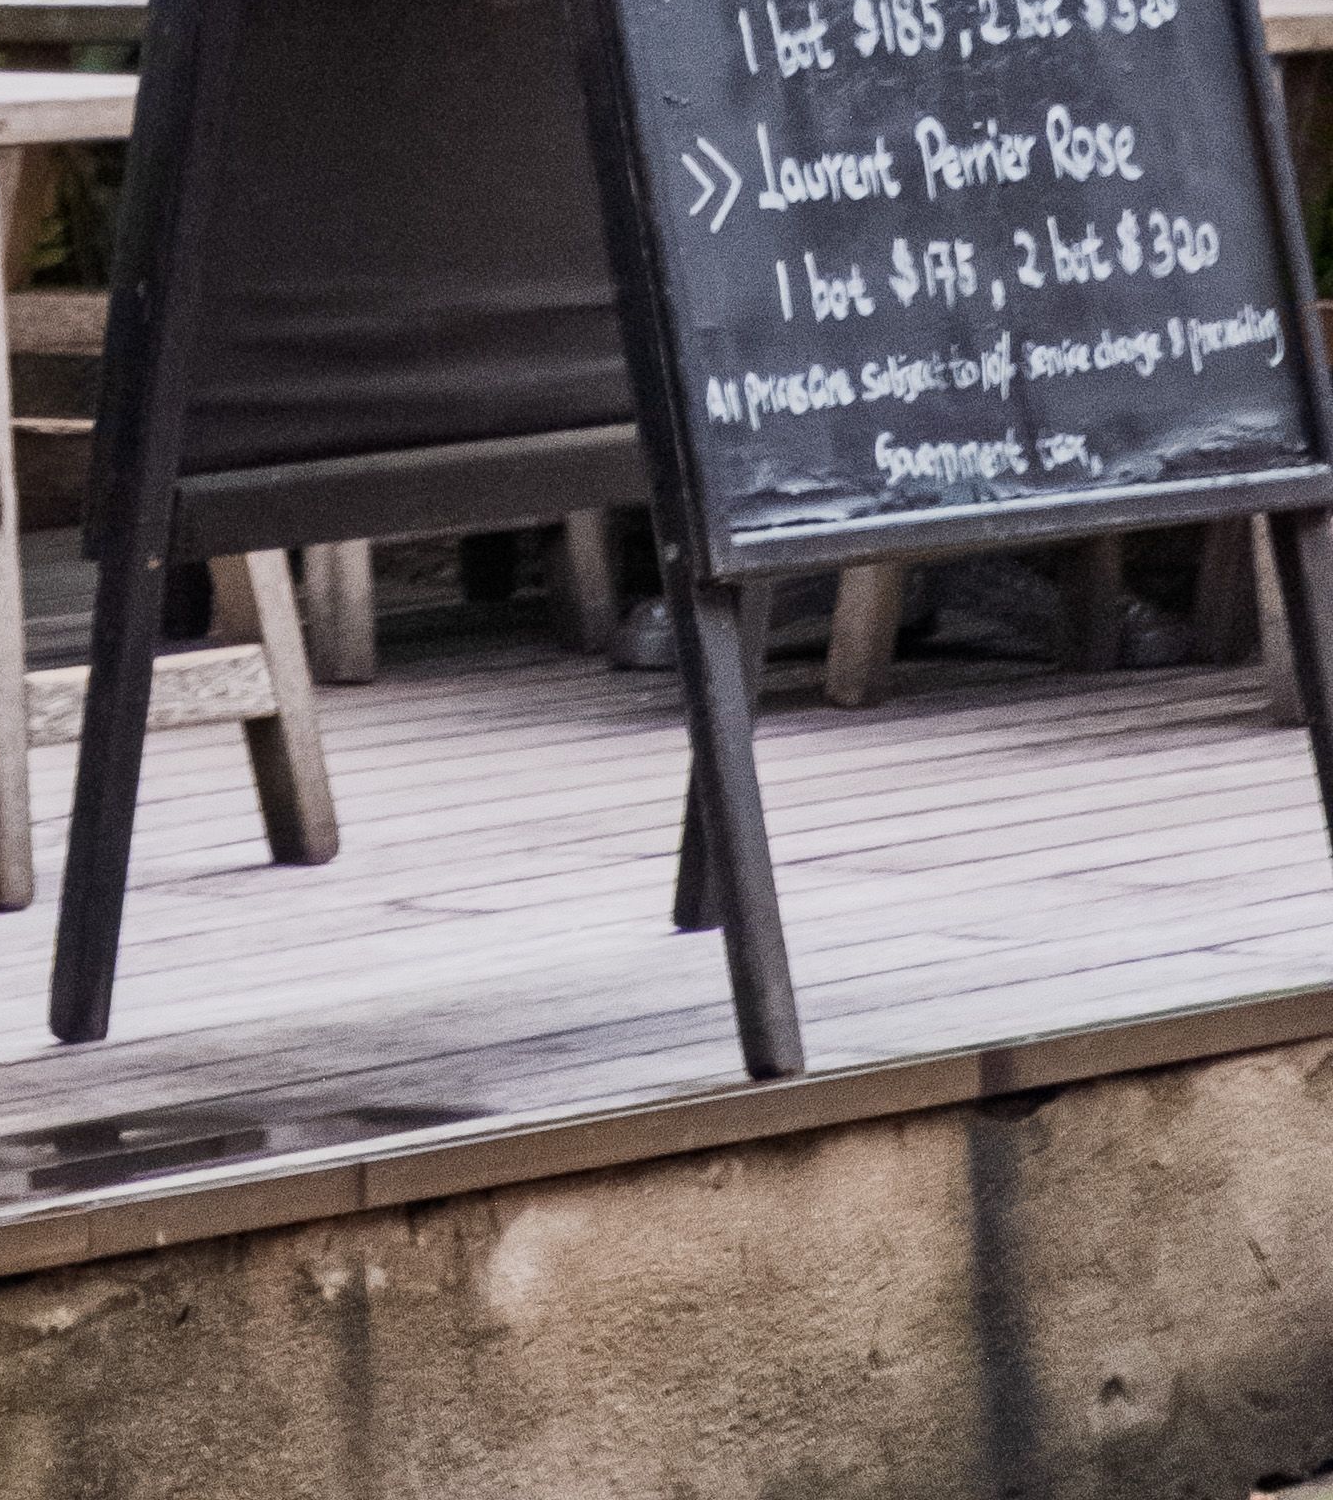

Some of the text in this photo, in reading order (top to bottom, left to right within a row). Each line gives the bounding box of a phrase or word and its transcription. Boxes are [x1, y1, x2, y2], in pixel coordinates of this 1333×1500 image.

[767, 0, 835, 78] bot
[756, 104, 1143, 211] Laurent Perrier Rose
[804, 251, 875, 323] bot
[1047, 215, 1113, 285] bot
[1117, 208, 1220, 278] $320
